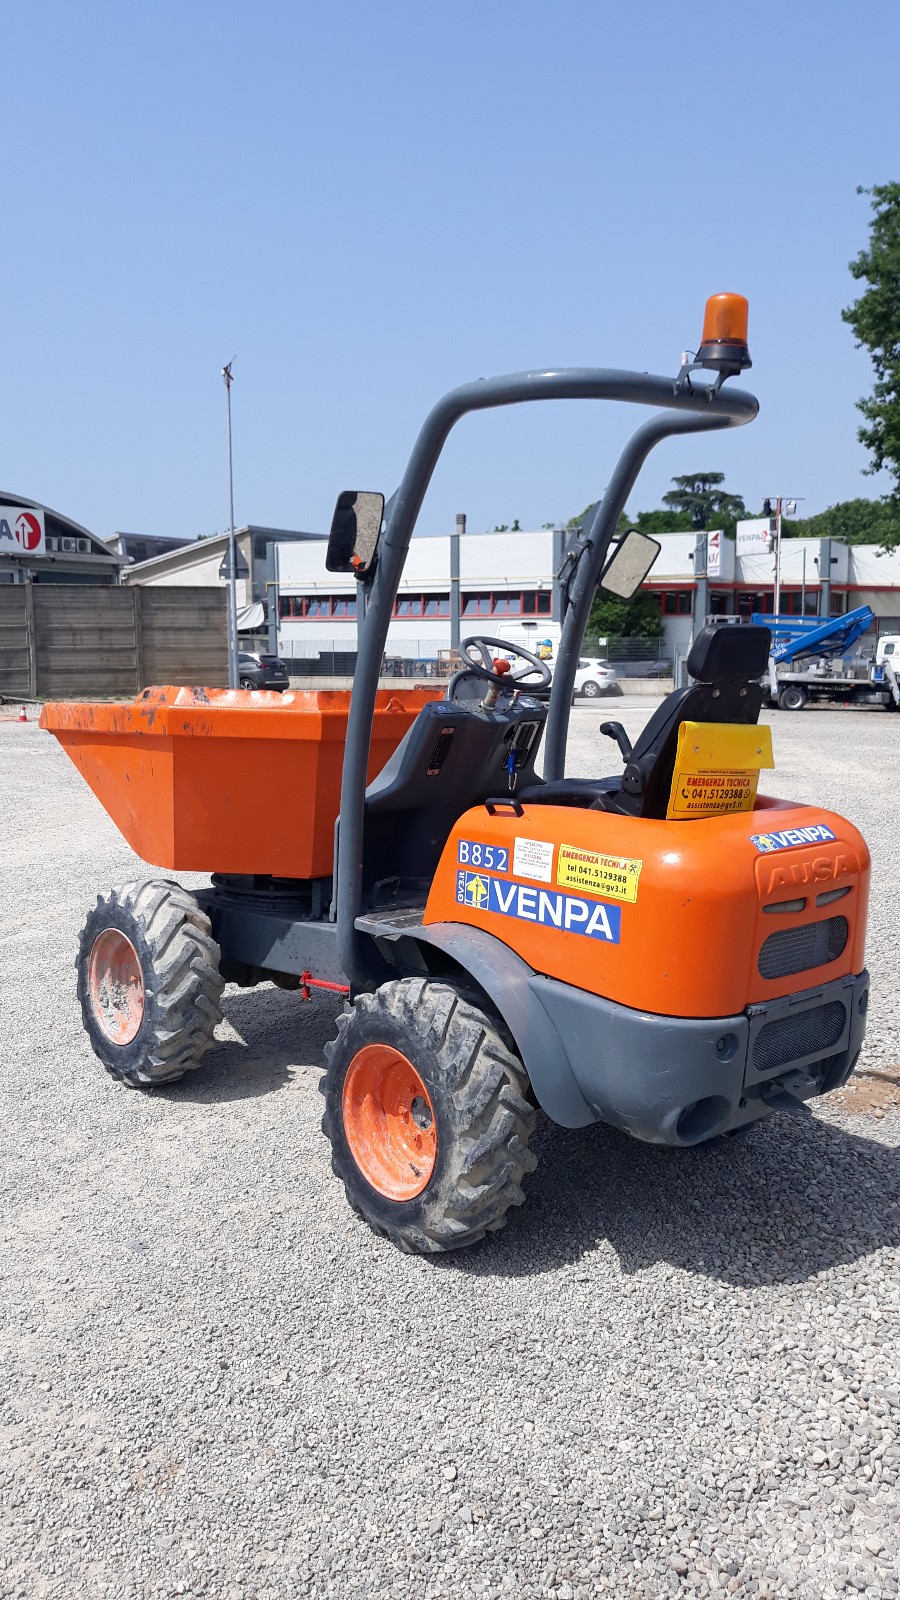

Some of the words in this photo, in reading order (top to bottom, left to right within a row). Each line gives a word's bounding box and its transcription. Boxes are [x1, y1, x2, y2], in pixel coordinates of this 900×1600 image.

[738, 533, 760, 542] VENPA
[687, 777, 725, 787] EMERGENZA
[727, 778, 750, 787] TECNICA
[692, 788, 743, 799] 041.5129388
[687, 801, 743, 810] assistenza@gv3.it
[769, 825, 835, 847] VENPA
[459, 841, 507, 871] B852
[562, 850, 599, 864] EMERGENZA
[567, 864, 577, 872] tel
[578, 865, 627, 884] 041.5129388
[767, 855, 850, 894] AUSA
[565, 875, 627, 894] assistenza@gv3.it
[493, 881, 614, 940] VENPA
